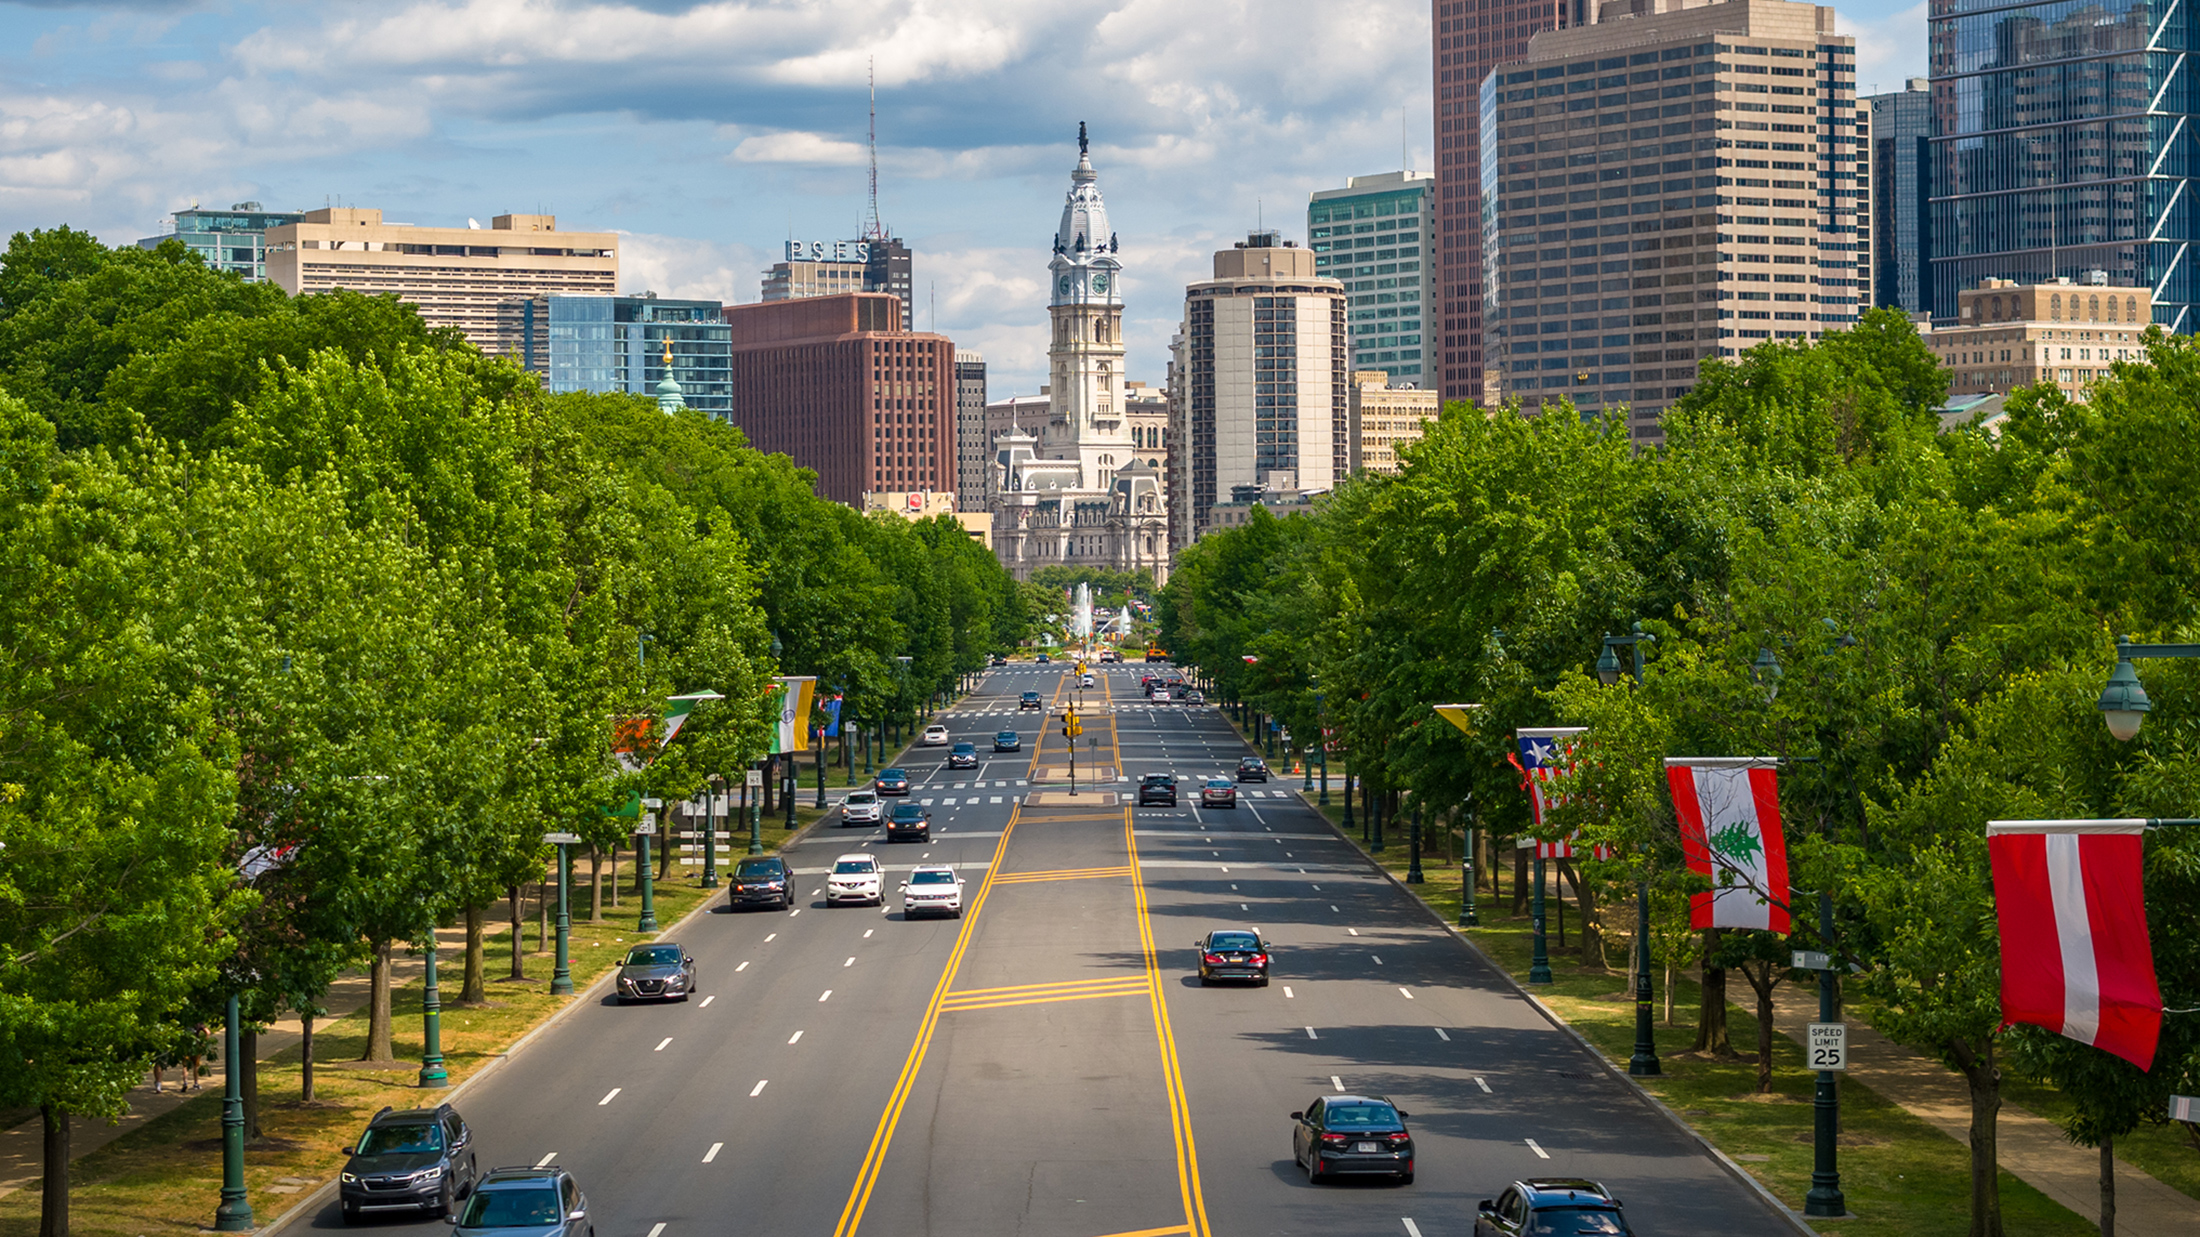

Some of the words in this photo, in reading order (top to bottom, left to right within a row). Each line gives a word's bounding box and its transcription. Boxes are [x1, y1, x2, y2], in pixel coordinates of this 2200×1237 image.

[791, 240, 869, 264] PSFS
[1811, 1028, 1843, 1037] SPEED
[1814, 1038, 1840, 1047] LIMIT
[1814, 1048, 1840, 1065] 25
